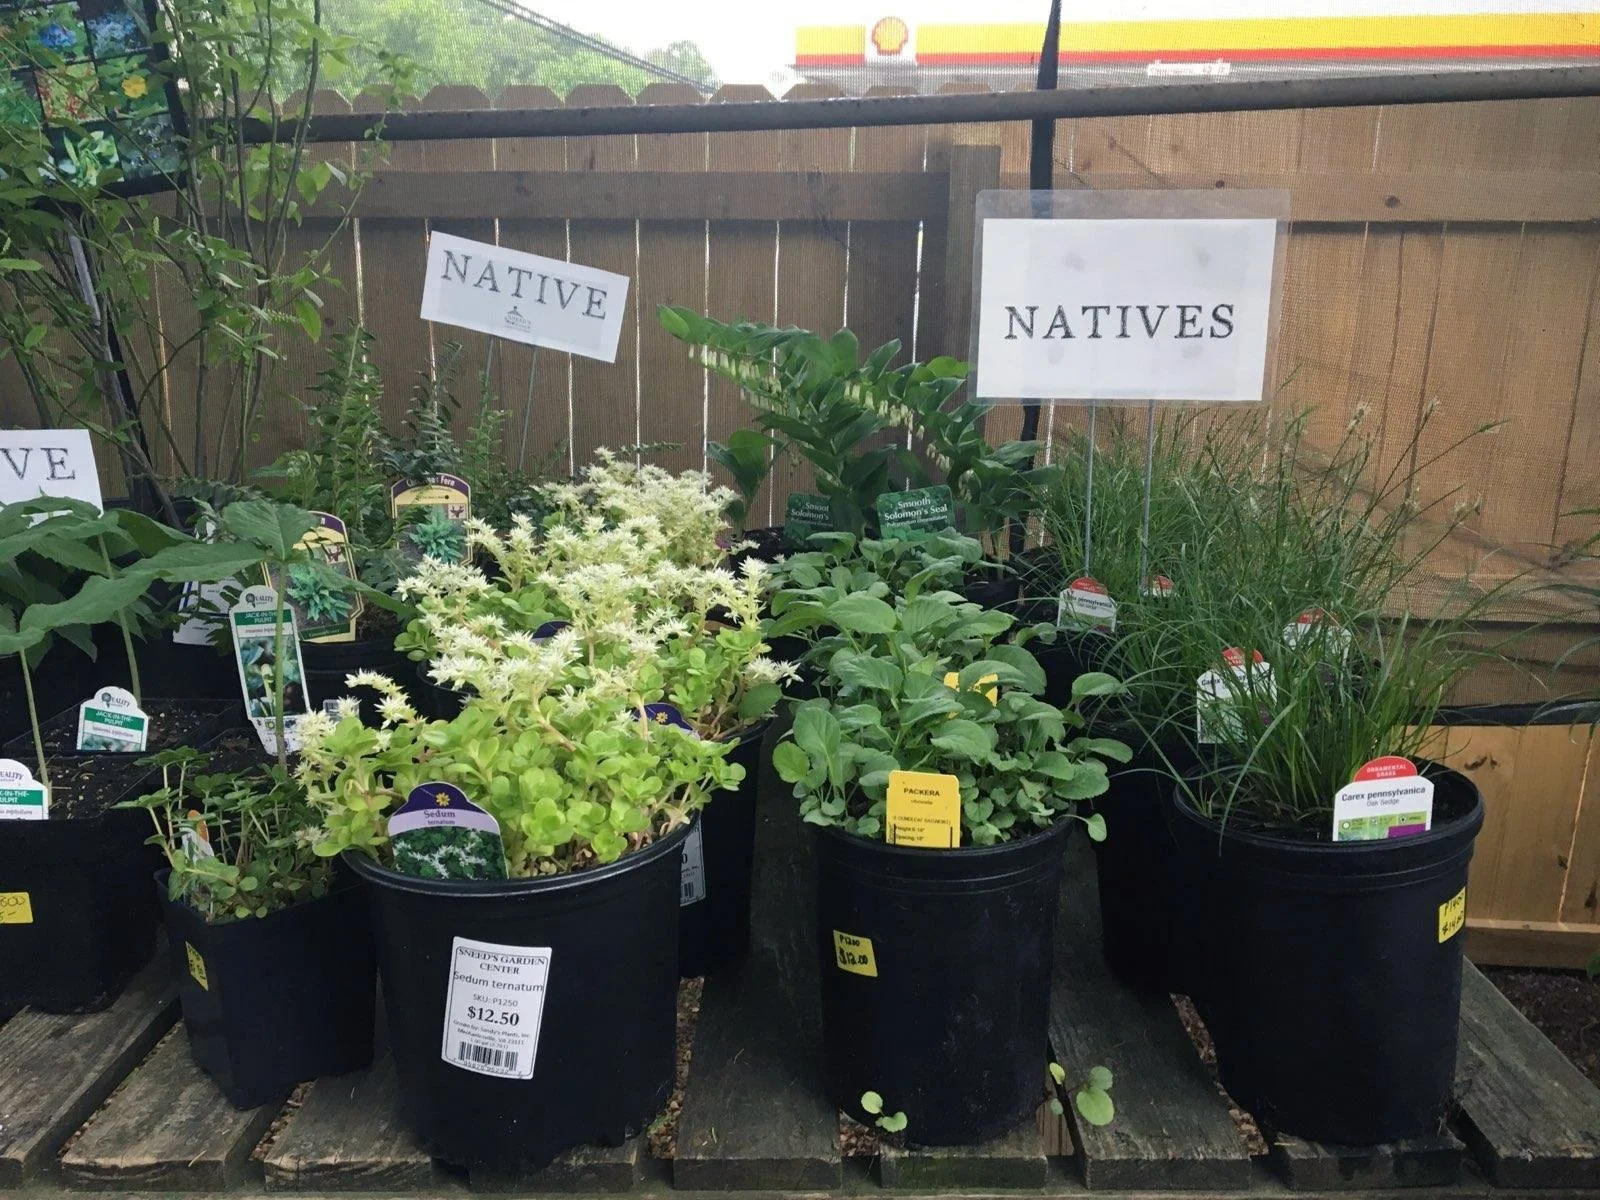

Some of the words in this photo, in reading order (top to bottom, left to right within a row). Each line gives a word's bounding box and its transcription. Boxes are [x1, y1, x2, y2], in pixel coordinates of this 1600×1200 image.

[441, 249, 608, 320] NATIVE
[1004, 303, 1235, 340] NATIVES
[898, 497, 931, 509] Smooth
[884, 507, 929, 520] Solomon's
[930, 503, 948, 514] Seal
[903, 787, 940, 797] PACKERA
[1341, 793, 1365, 802] Carex
[1367, 787, 1426, 800] pennsylvanica
[1380, 798, 1400, 806] Sedge
[423, 809, 456, 819] Sedum
[458, 948, 499, 962] SNEED'S
[500, 956, 545, 966] GARDEN
[479, 963, 520, 975] CENTER
[453, 970, 489, 987] Sedum
[491, 979, 544, 992] ternatum
[473, 993, 491, 1004] SKU:
[492, 997, 519, 1008] P1250
[467, 1005, 520, 1027] $12.50
